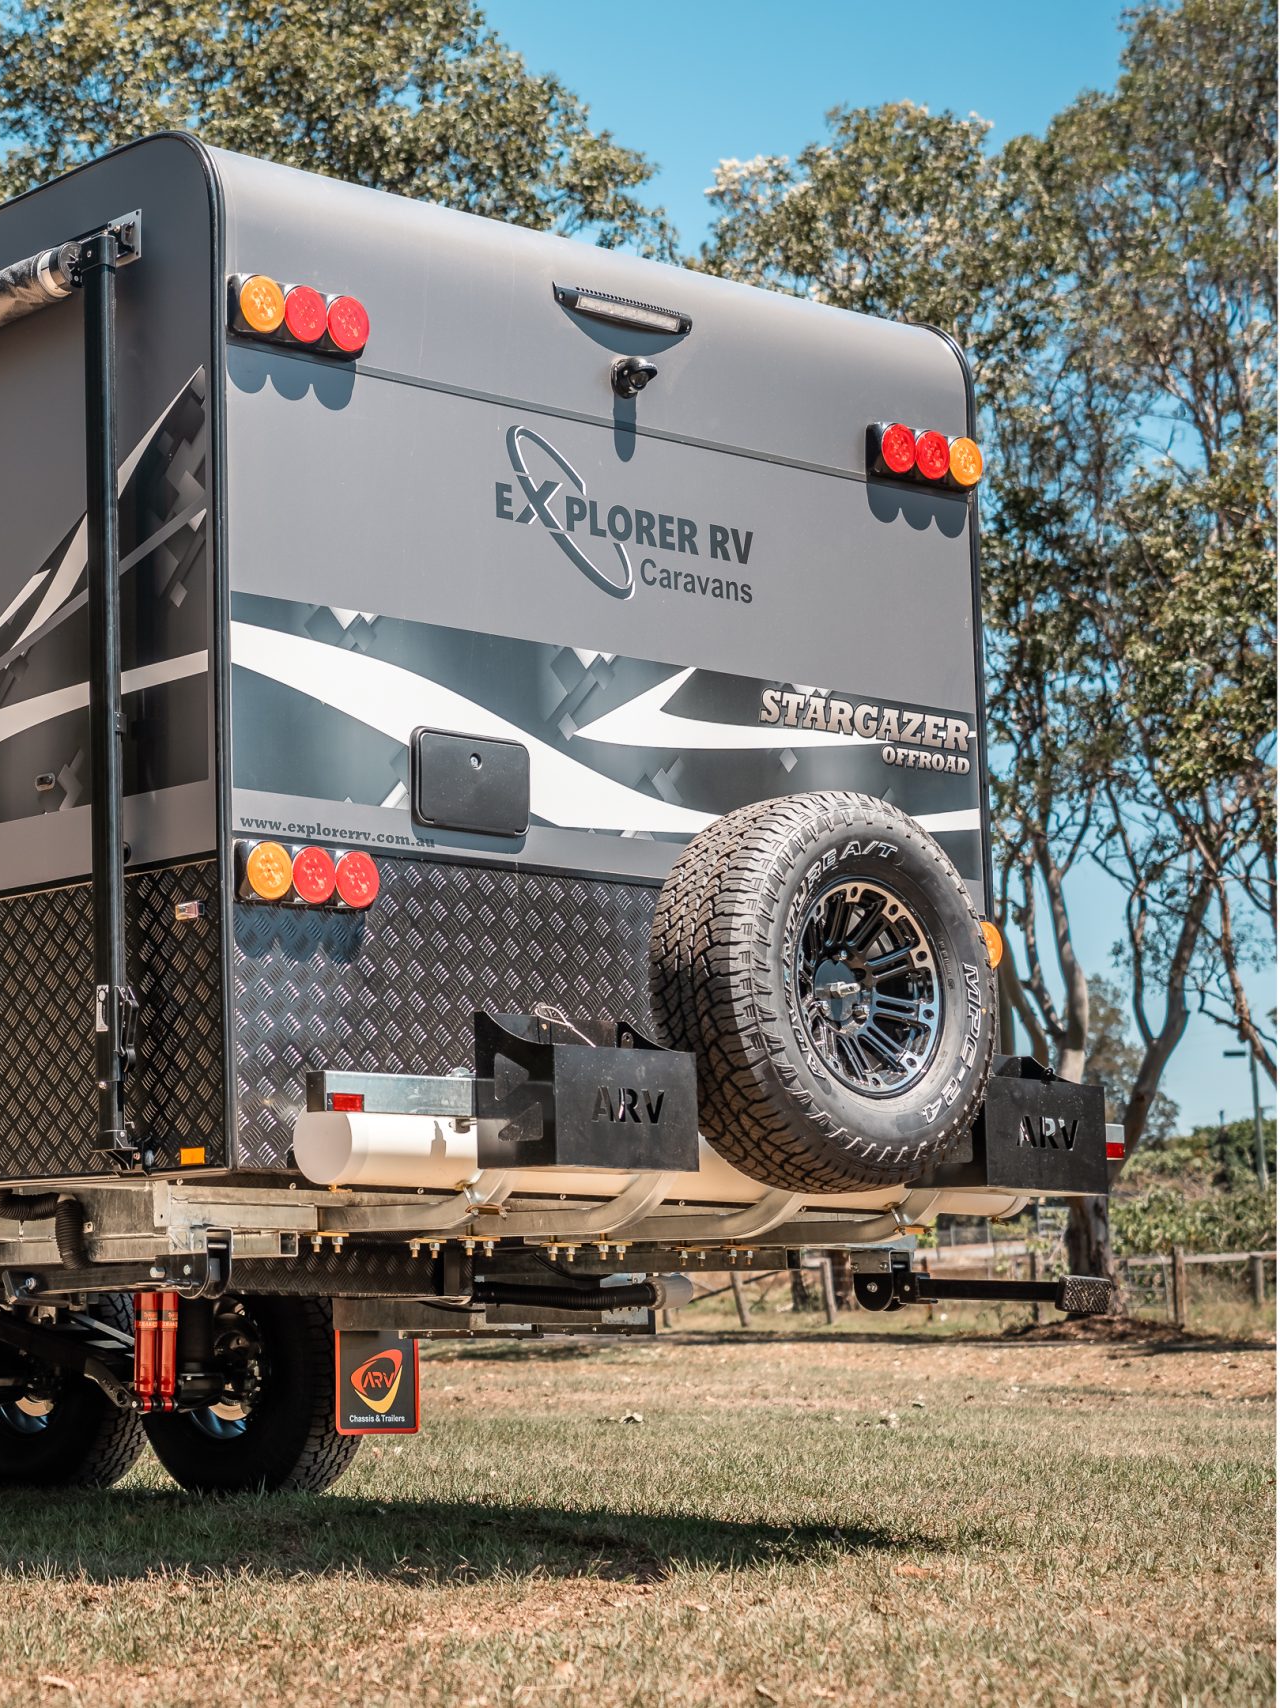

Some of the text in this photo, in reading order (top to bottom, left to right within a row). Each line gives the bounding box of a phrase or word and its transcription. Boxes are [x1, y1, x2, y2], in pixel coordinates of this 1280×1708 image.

[494, 473, 754, 565] EXPLORER RV
[639, 557, 754, 604] Caravans
[759, 687, 970, 752] STARGAZER
[881, 744, 971, 776] OFFROAD
[239, 815, 436, 849] www.explorerrv.com.au
[838, 839, 899, 860] A/T
[921, 961, 983, 1125] MPC-24
[591, 1086, 665, 1125] ARV
[1016, 1114, 1080, 1151] ARV
[362, 1371, 396, 1389] ARV
[349, 1414, 405, 1422] Chassis & Trailers
